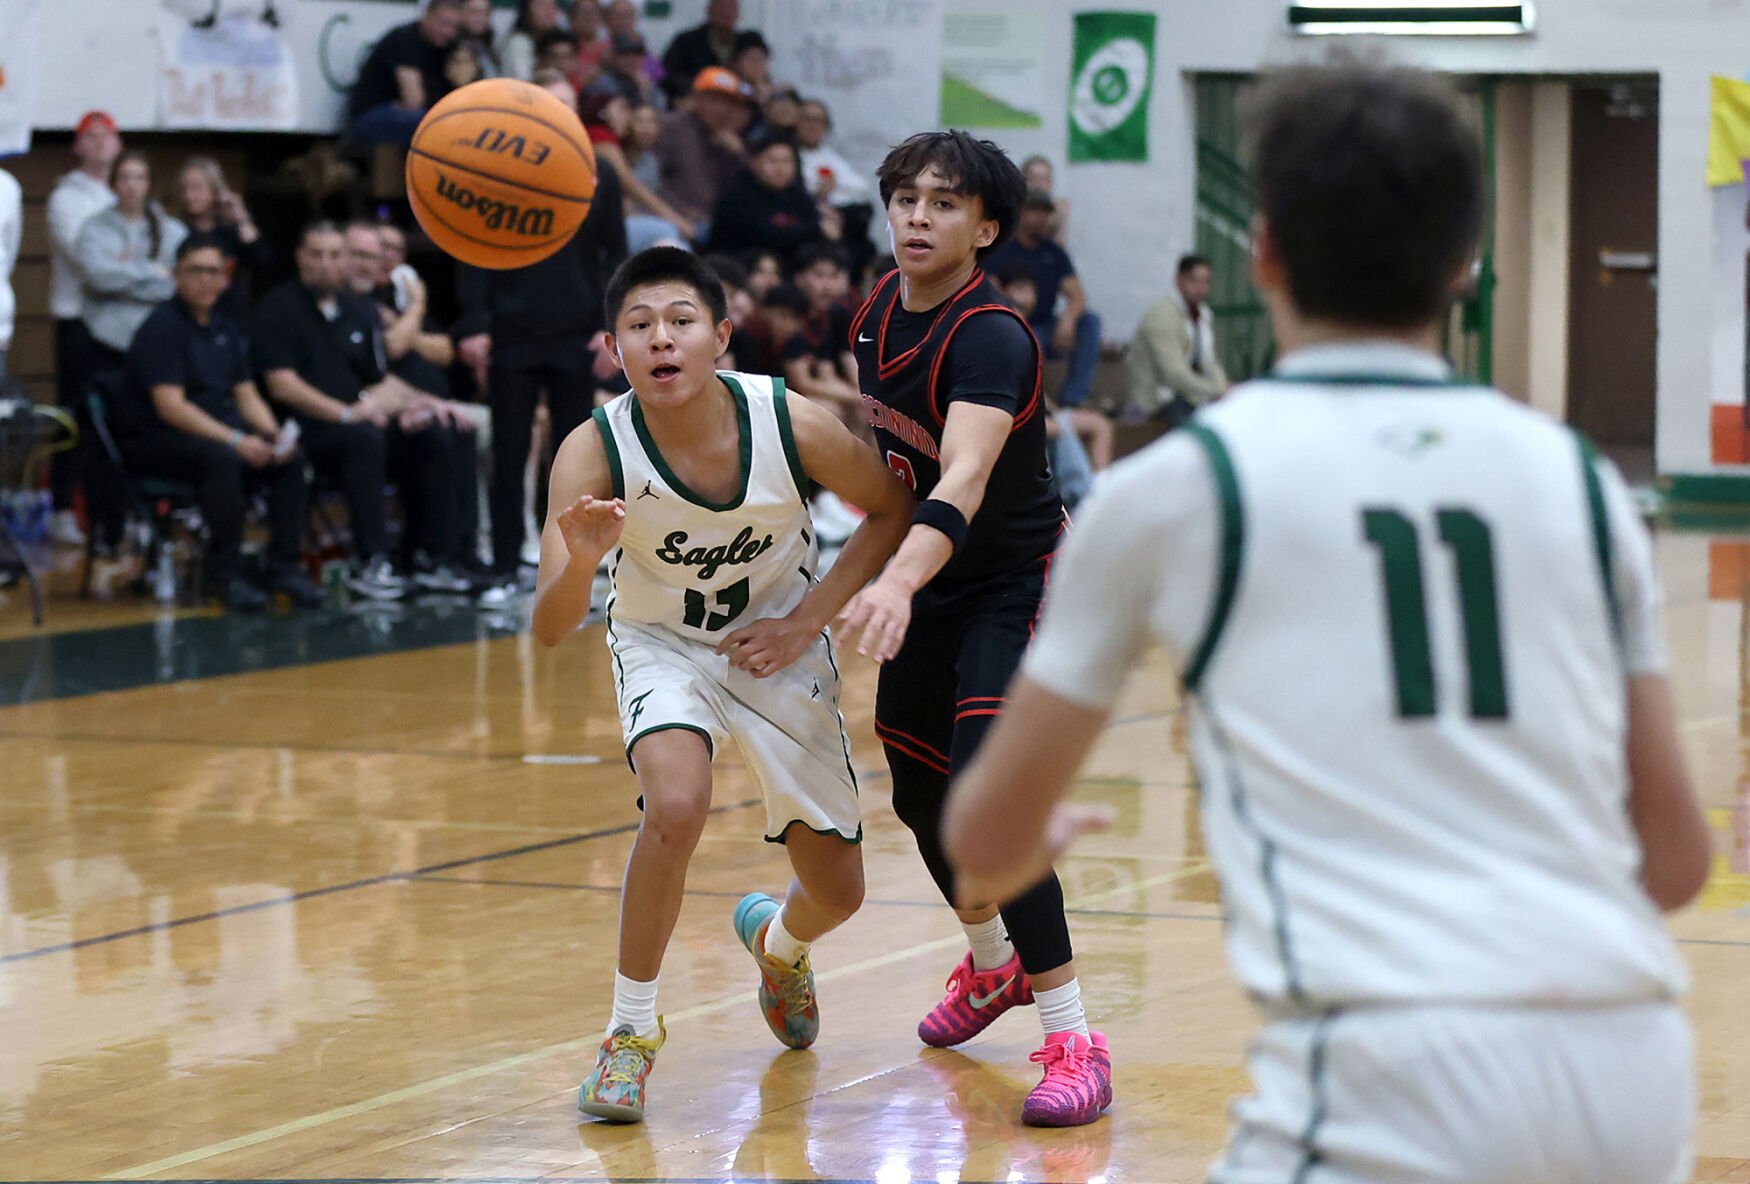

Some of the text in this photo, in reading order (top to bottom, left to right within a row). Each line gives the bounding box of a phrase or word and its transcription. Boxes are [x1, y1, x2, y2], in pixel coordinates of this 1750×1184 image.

[473, 127, 552, 166] EVO
[436, 174, 555, 236] Wilson
[1360, 508, 1511, 720] 11
